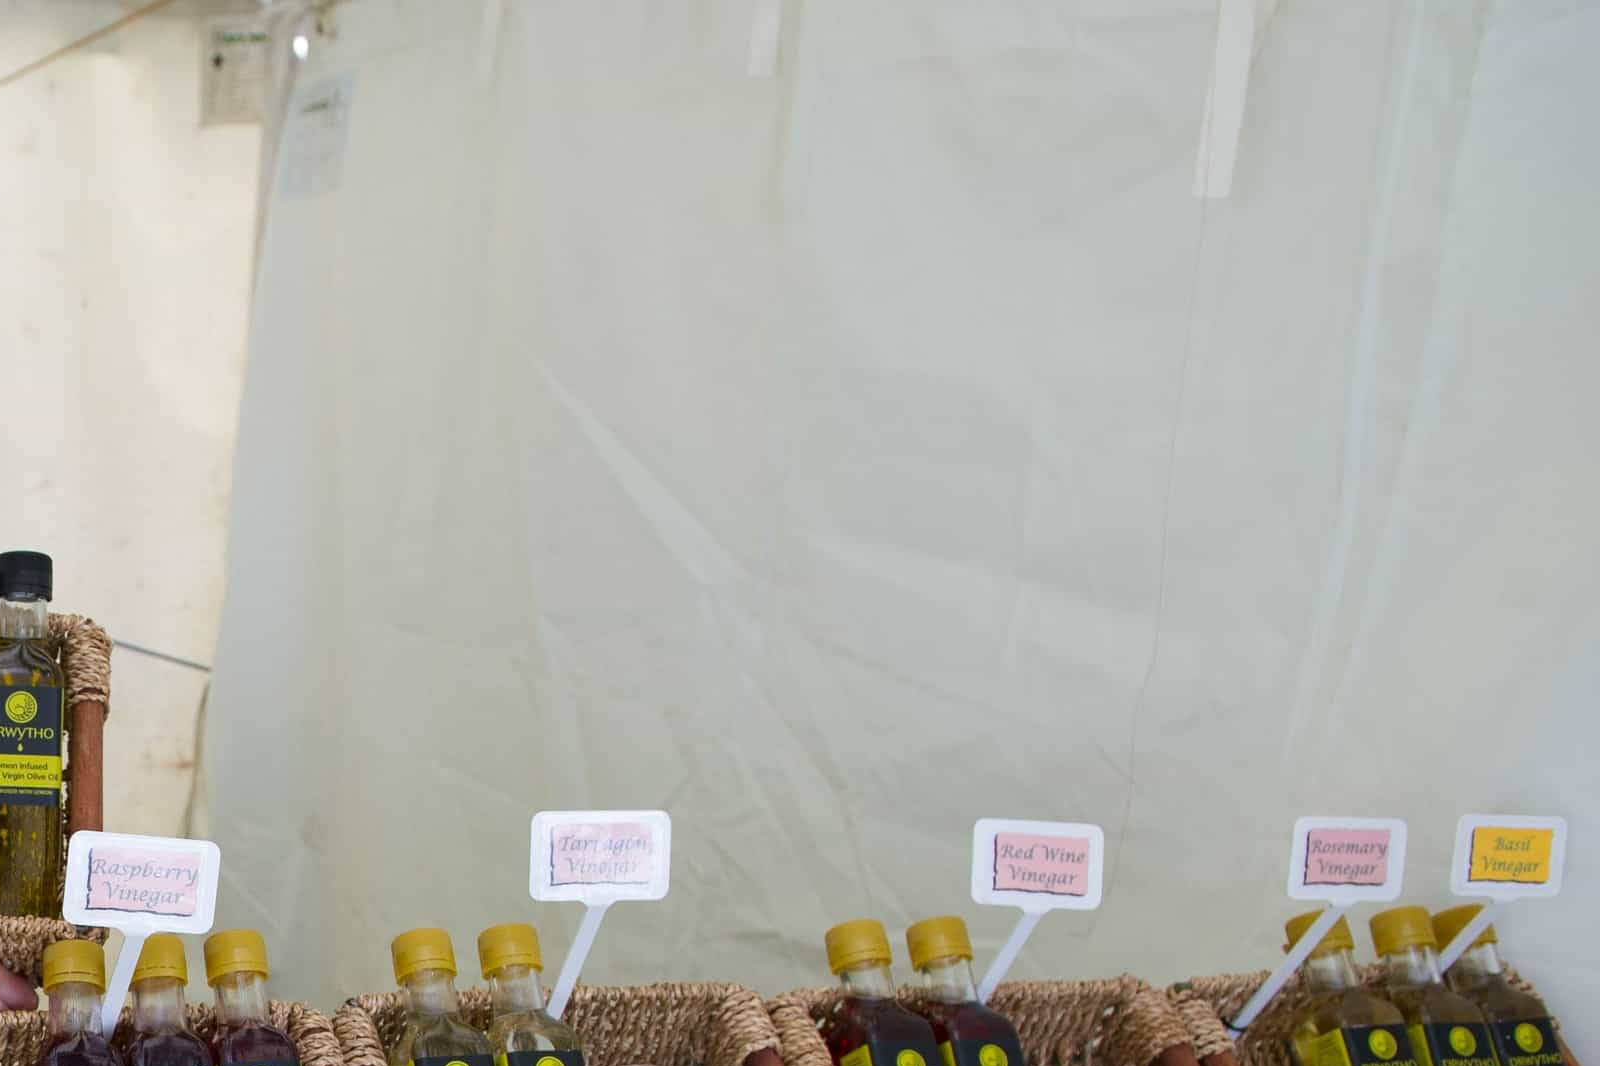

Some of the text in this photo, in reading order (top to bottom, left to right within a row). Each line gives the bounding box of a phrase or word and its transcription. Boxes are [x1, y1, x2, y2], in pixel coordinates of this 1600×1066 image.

[19, 762, 48, 770] Infused
[1001, 844, 1085, 863] Red Wine
[1310, 840, 1387, 860] Rosemary
[1493, 836, 1531, 852] Basil
[93, 857, 199, 886] Raspberry
[1008, 864, 1077, 887] Vinegar
[1316, 861, 1377, 879] Vinegar
[1481, 856, 1540, 876] Vinegar
[103, 881, 184, 908] Vinegar
